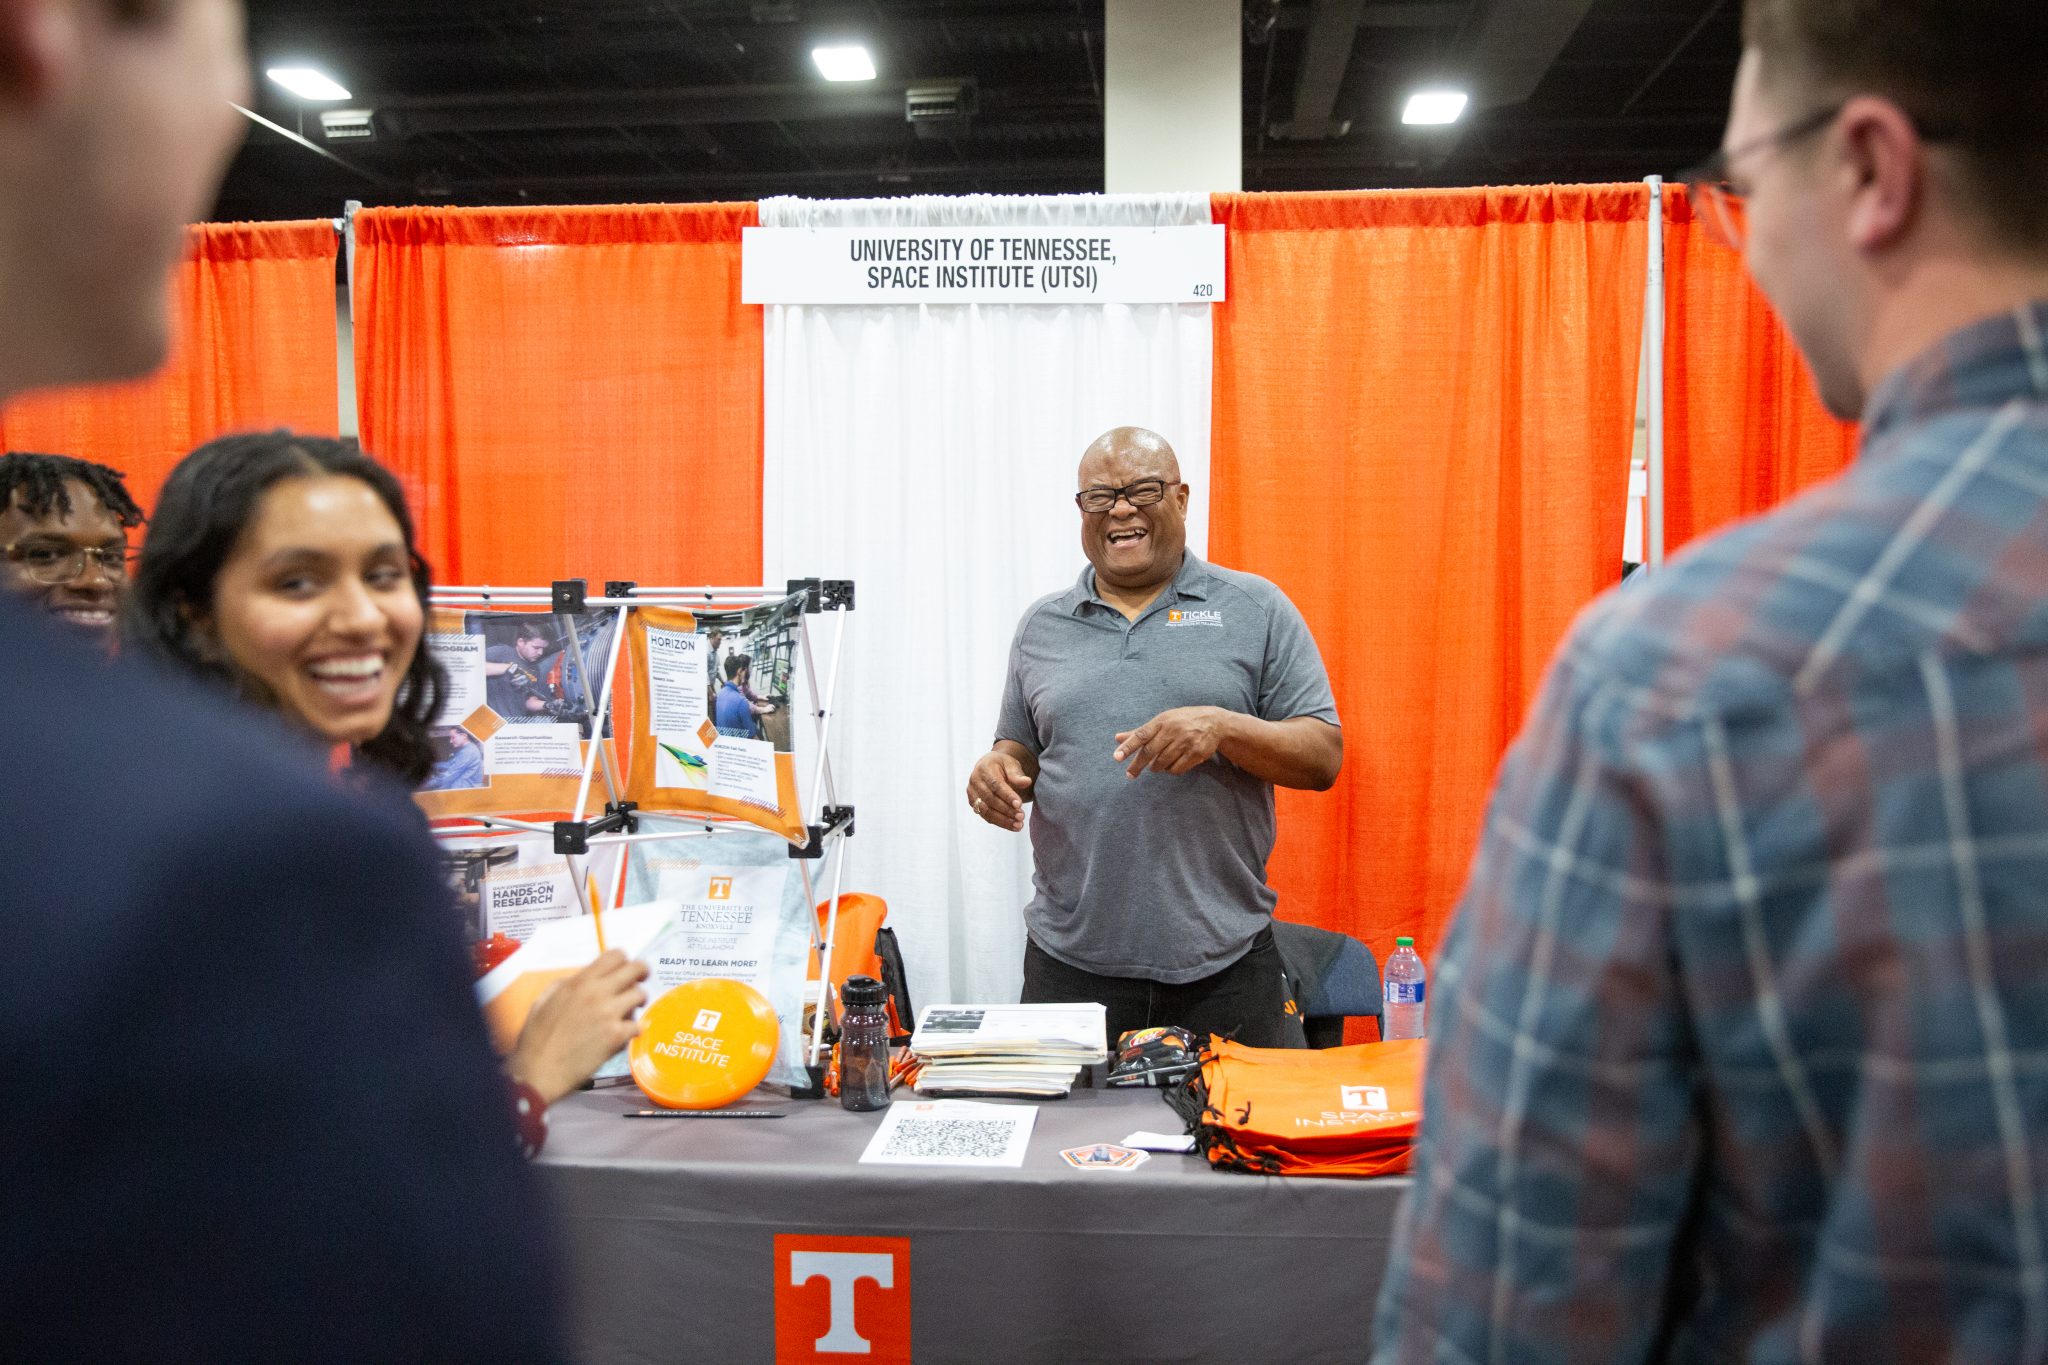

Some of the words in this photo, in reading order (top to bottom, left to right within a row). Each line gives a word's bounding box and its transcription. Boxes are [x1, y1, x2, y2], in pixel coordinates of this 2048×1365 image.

[850, 238, 964, 261] UNIVERSITY
[970, 238, 994, 261] OF
[1000, 238, 1116, 265] TENNESSEE,
[867, 265, 929, 288] SPACE
[936, 265, 1034, 288] INSTITUTE
[1041, 265, 1098, 294] (UTSI)
[1192, 284, 1213, 297] 420
[1182, 610, 1221, 619] TICKLE
[651, 635, 695, 650] HORIZON
[493, 884, 555, 900] HANDS-ON
[493, 894, 553, 908] RESEARCH
[697, 904, 742, 912] UNIVERSITY
[680, 911, 753, 924] TENNESSEE
[659, 957, 687, 965] READY
[689, 958, 700, 966] TO
[701, 959, 729, 967] LEARN
[730, 960, 758, 968] MORE?
[673, 1031, 724, 1051] SPACE
[654, 1041, 731, 1067] INSTITUTE
[790, 1250, 894, 1354] T
